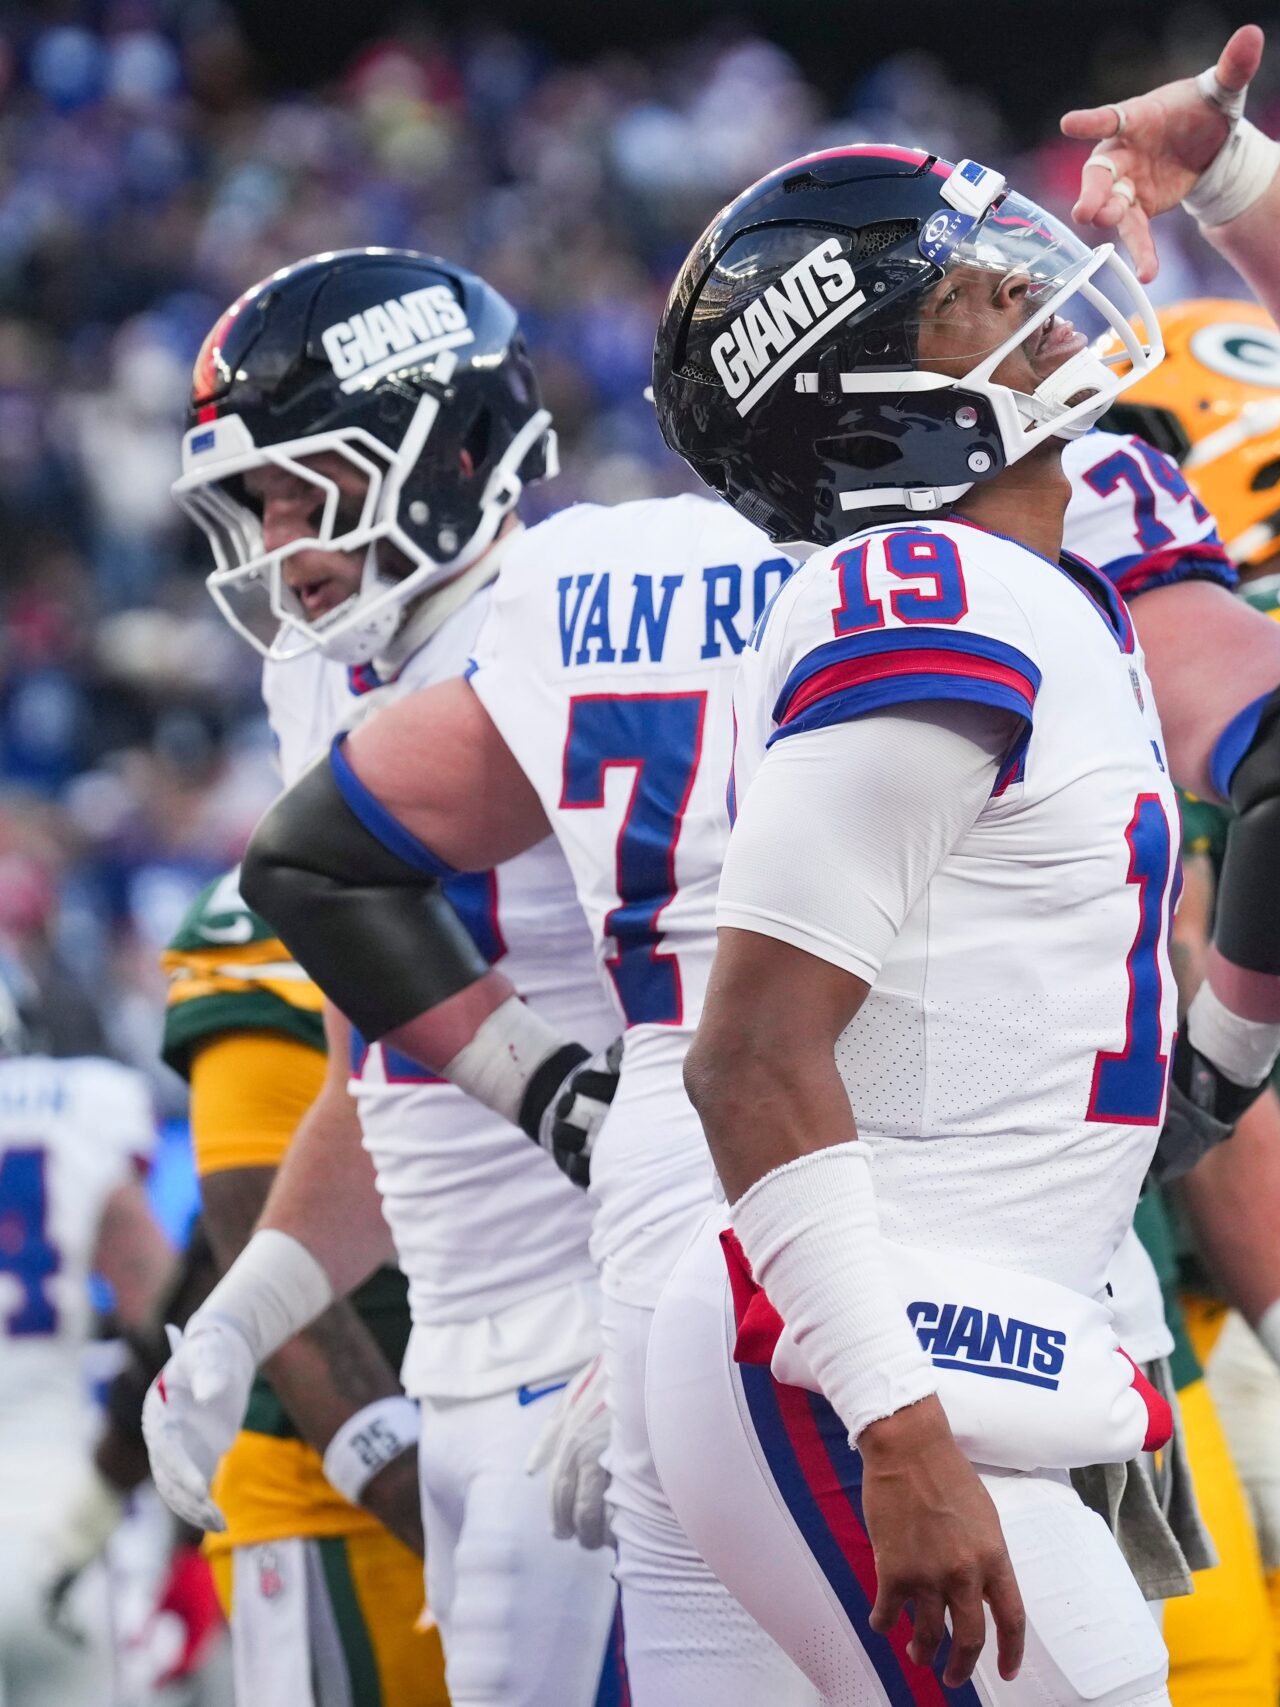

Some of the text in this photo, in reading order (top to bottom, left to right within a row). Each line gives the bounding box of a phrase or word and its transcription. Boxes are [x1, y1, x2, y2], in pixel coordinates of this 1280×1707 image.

[928, 214, 963, 258] OAKLEY
[321, 284, 470, 380] GIANTS
[711, 237, 857, 399] GIANTS
[556, 571, 684, 668] VAN
[830, 530, 969, 637] 19
[558, 690, 737, 1028] 7
[1085, 792, 1184, 1127] 1
[906, 1301, 1067, 1376] GIANTS
